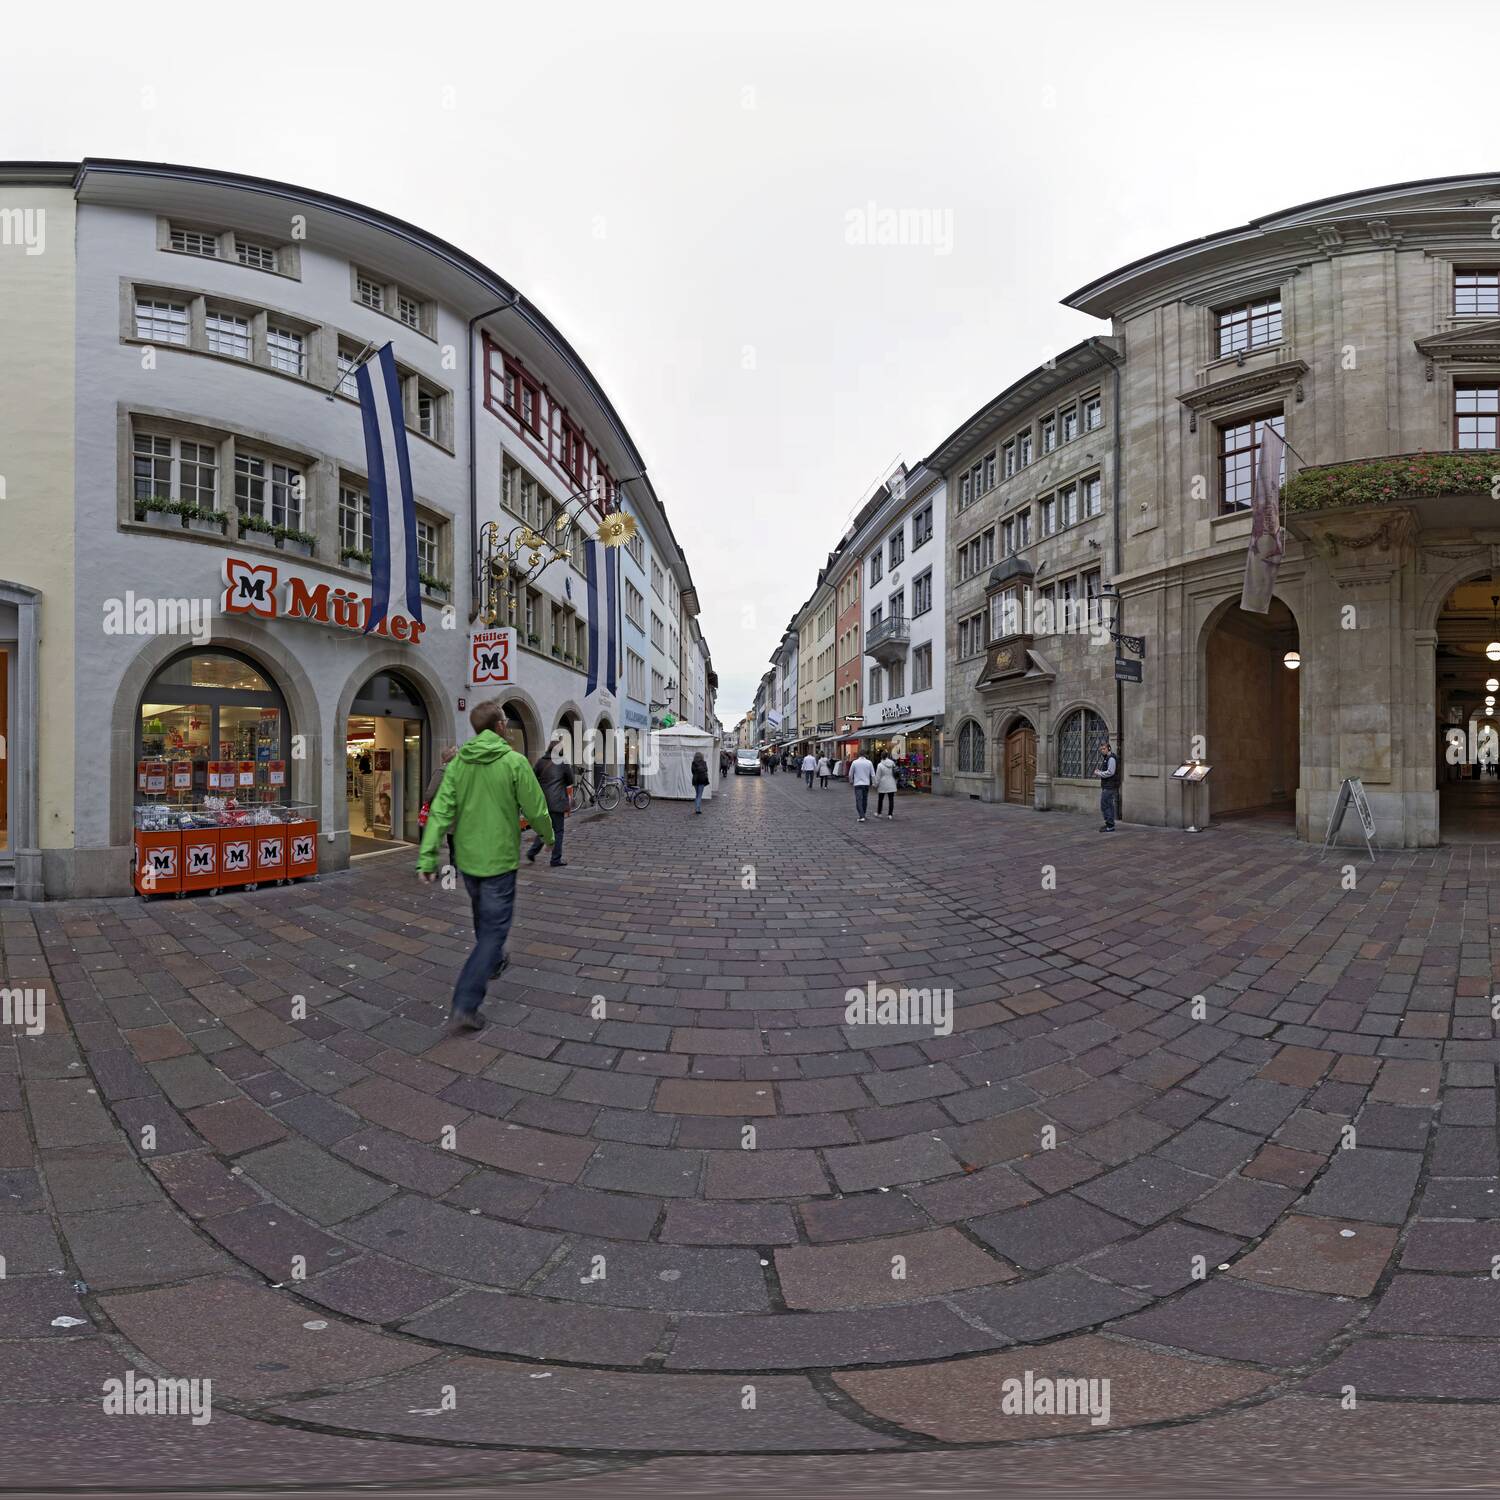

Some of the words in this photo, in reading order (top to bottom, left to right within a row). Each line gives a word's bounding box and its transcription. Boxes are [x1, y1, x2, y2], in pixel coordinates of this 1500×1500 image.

[238, 576, 265, 602] M
[473, 632, 508, 643] Müller
[481, 652, 500, 670] M
[230, 850, 244, 862] M
[264, 846, 278, 859] M
[296, 843, 310, 856] M
[154, 856, 170, 869] M
[194, 853, 209, 866] M
